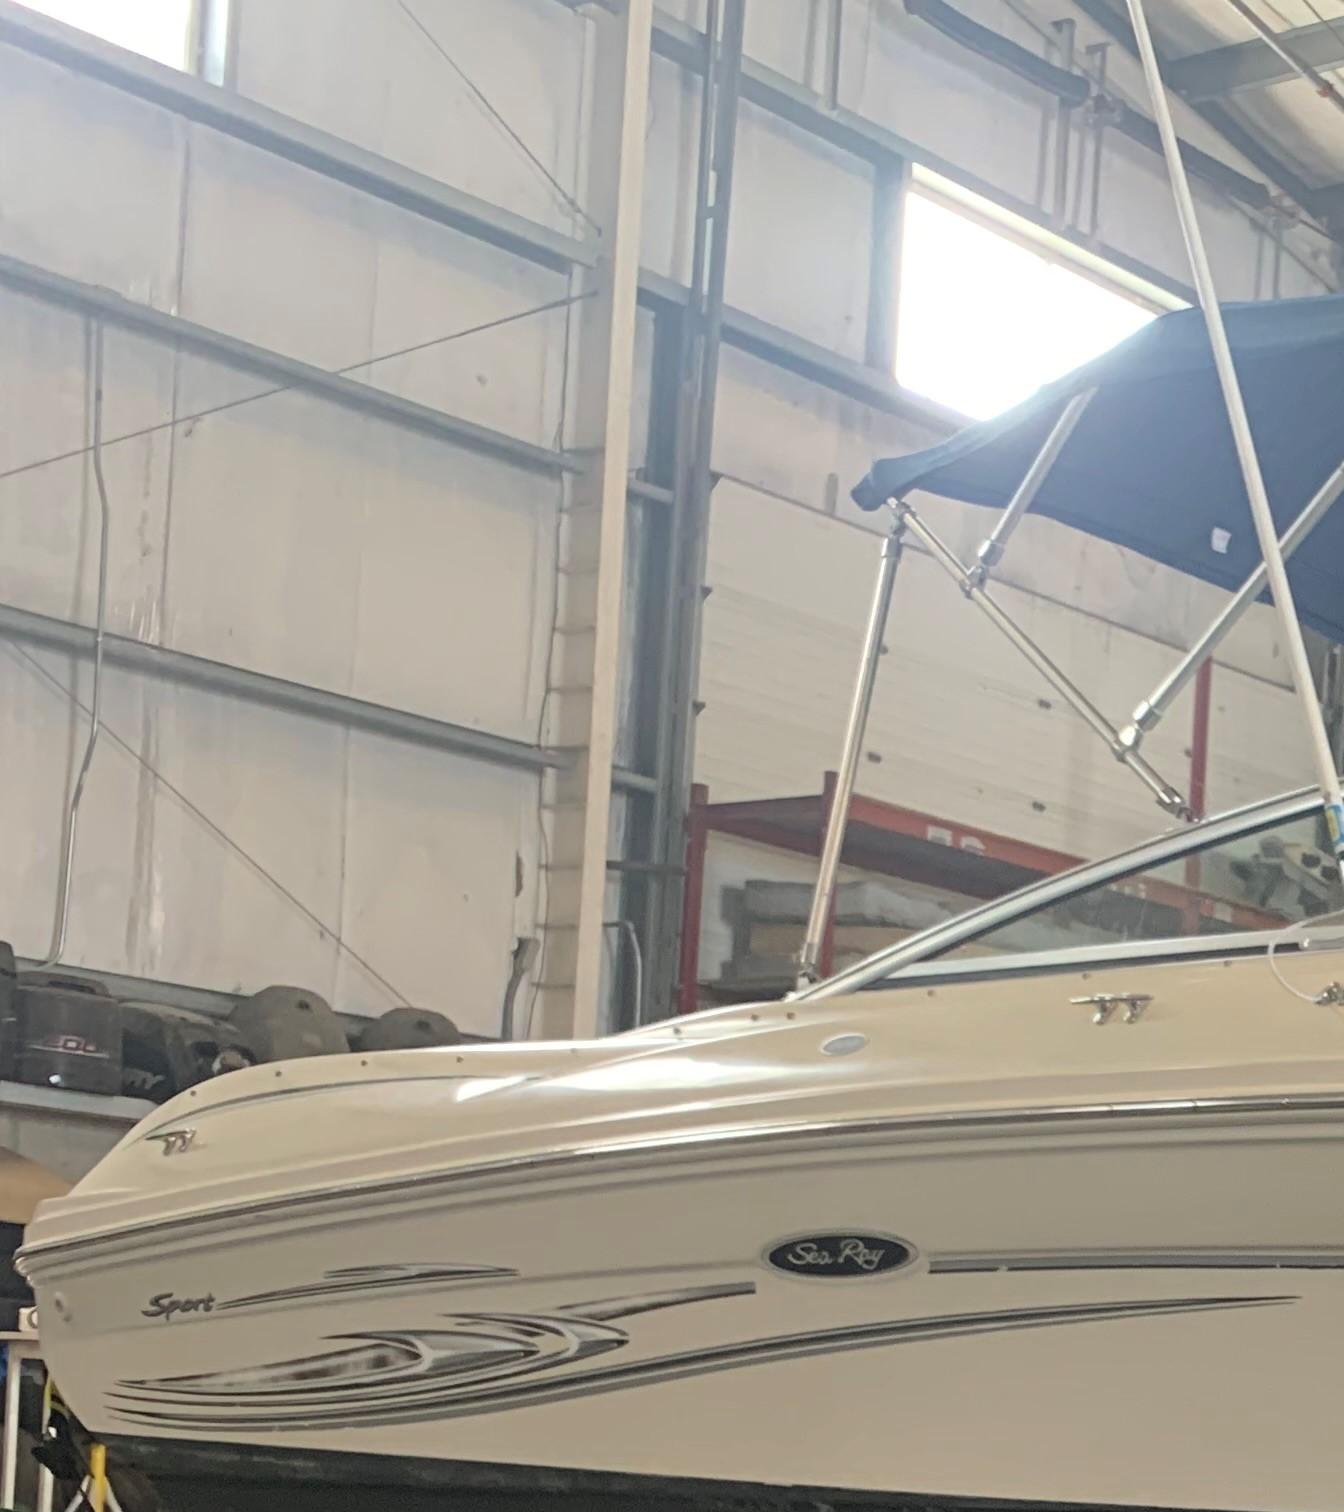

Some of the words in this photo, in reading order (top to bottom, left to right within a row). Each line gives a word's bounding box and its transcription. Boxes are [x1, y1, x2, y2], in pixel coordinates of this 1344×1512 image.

[787, 1242, 833, 1265] Sea
[837, 1238, 886, 1271] Ray
[141, 1292, 216, 1321] Sport
